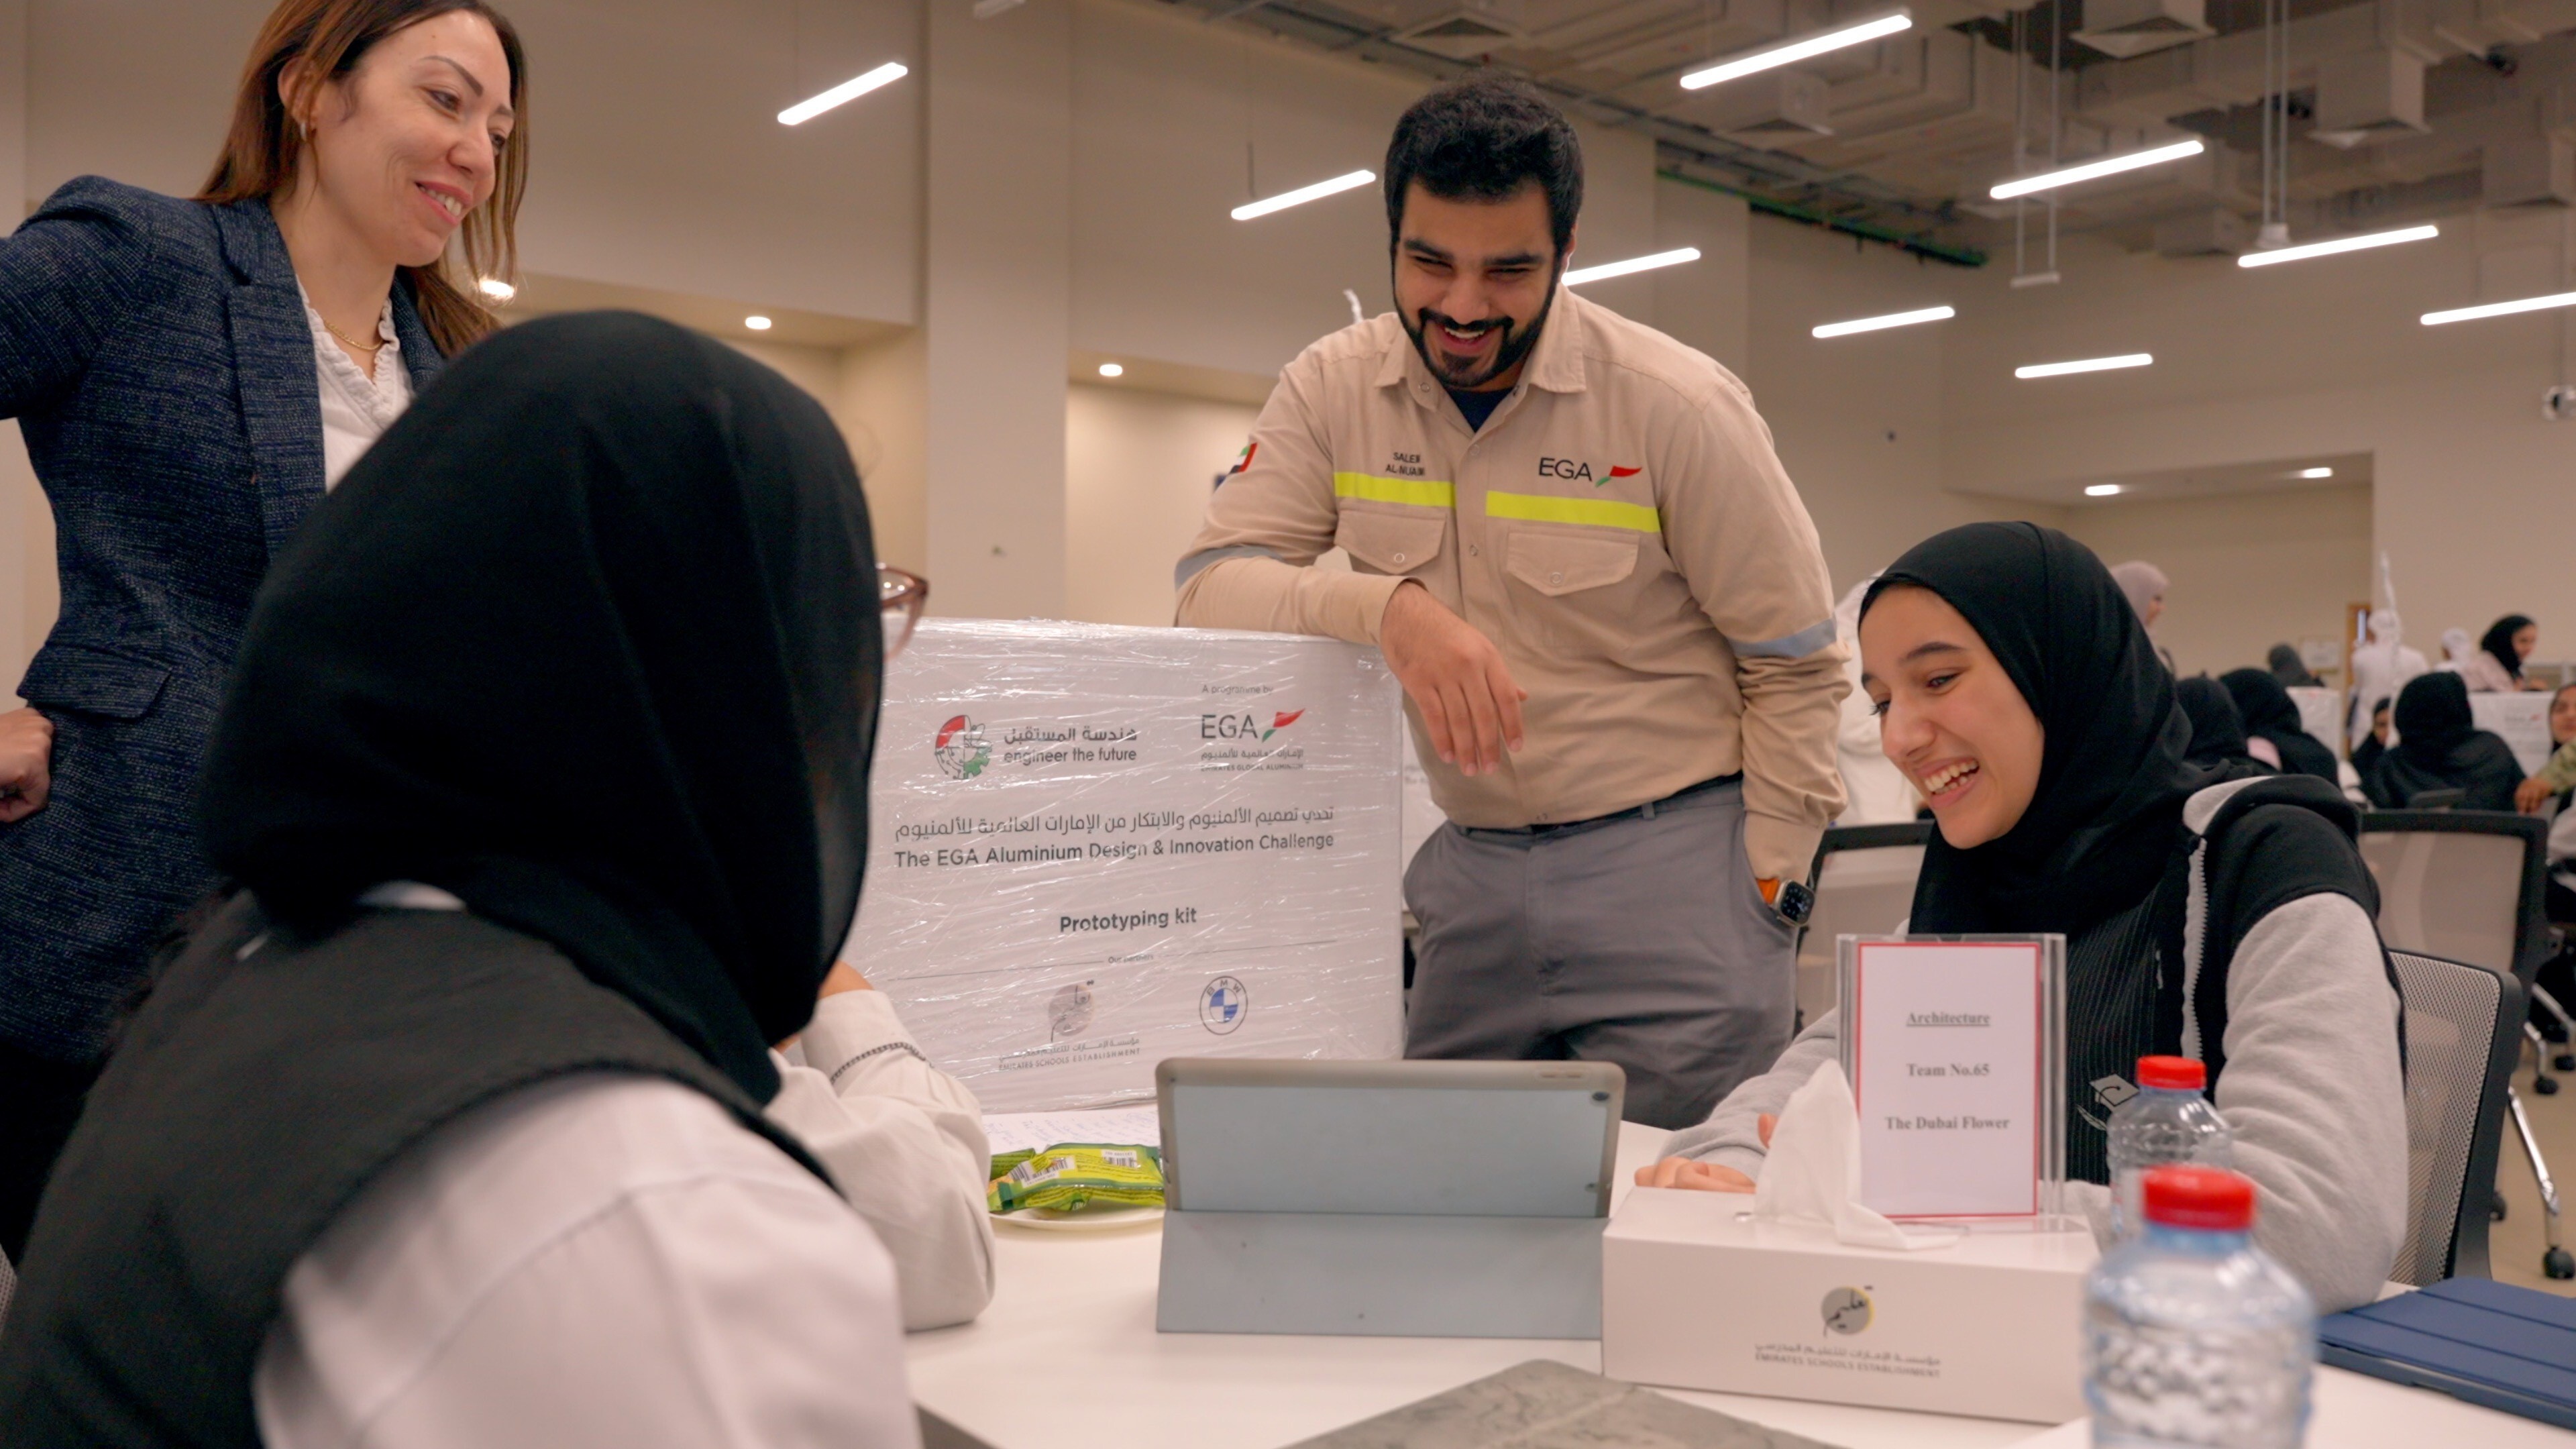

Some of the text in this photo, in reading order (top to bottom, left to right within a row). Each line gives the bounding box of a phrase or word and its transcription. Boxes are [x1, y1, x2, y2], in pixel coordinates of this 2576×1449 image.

[1539, 457, 1593, 482] EGA
[1201, 684, 1273, 696] A programme by
[1004, 725, 1137, 745] هندسة المستقبل
[1201, 714, 1258, 739] EGA
[1004, 747, 1137, 766] engineer the future
[895, 806, 1334, 843] تحدي تصميم الألمنيوم والابتكار من الإمارات العالمية للألمنيوم
[895, 833, 1334, 867] The EGA Aluminium Design & Innovation Challenge
[1060, 907, 1197, 932] Prototyping kit
[1108, 956, 1122, 964] Our
[1907, 1012, 1990, 1026] Architecture
[1035, 1056, 1070, 1067] SCHOOLS
[1073, 1048, 1140, 1062] ESTABLISHMENT
[1907, 1063, 1990, 1077] Team No.65
[1885, 1116, 2010, 1130] The Dubai Flower
[1754, 1352, 1804, 1365] EMIRATES
[1807, 1356, 1854, 1371] SCHOOLS
